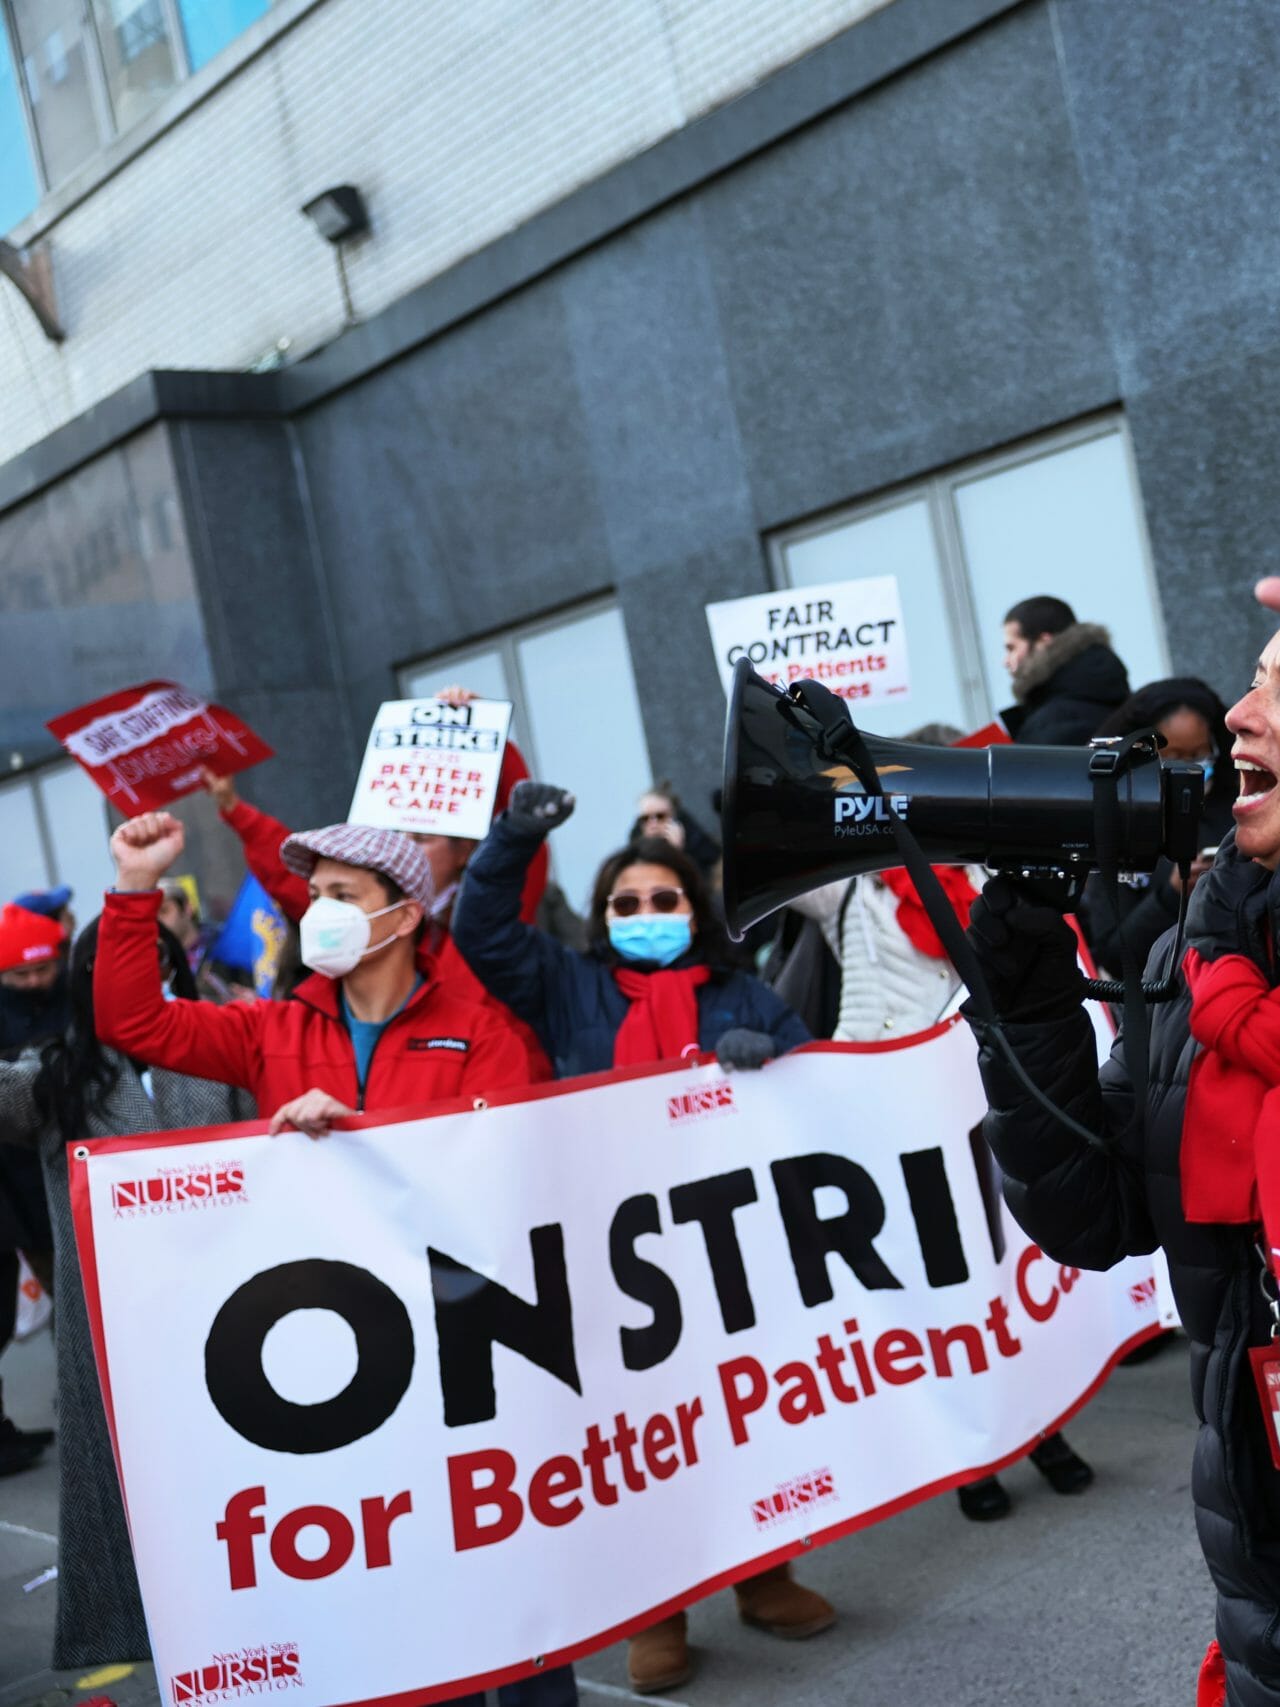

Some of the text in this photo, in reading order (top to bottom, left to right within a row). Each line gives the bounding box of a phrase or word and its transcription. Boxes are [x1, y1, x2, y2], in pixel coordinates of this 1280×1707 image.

[768, 601, 834, 631] FAIR
[727, 620, 896, 667] CONTRACT
[787, 654, 886, 682] Patients
[411, 705, 472, 726] ON
[375, 727, 500, 750] STRIKE
[380, 765, 481, 782] BETTER
[370, 780, 485, 799] PATIENT
[388, 798, 461, 813] CARE
[834, 795, 909, 823] PYLE
[111, 1168, 245, 1209] NURSES
[607, 1118, 1007, 1371] STRI
[204, 1222, 583, 1455] ON
[216, 1485, 412, 1591] for
[446, 1395, 705, 1553] Better
[718, 1296, 1022, 1446] Patient
[171, 1652, 301, 1704] NURSES
